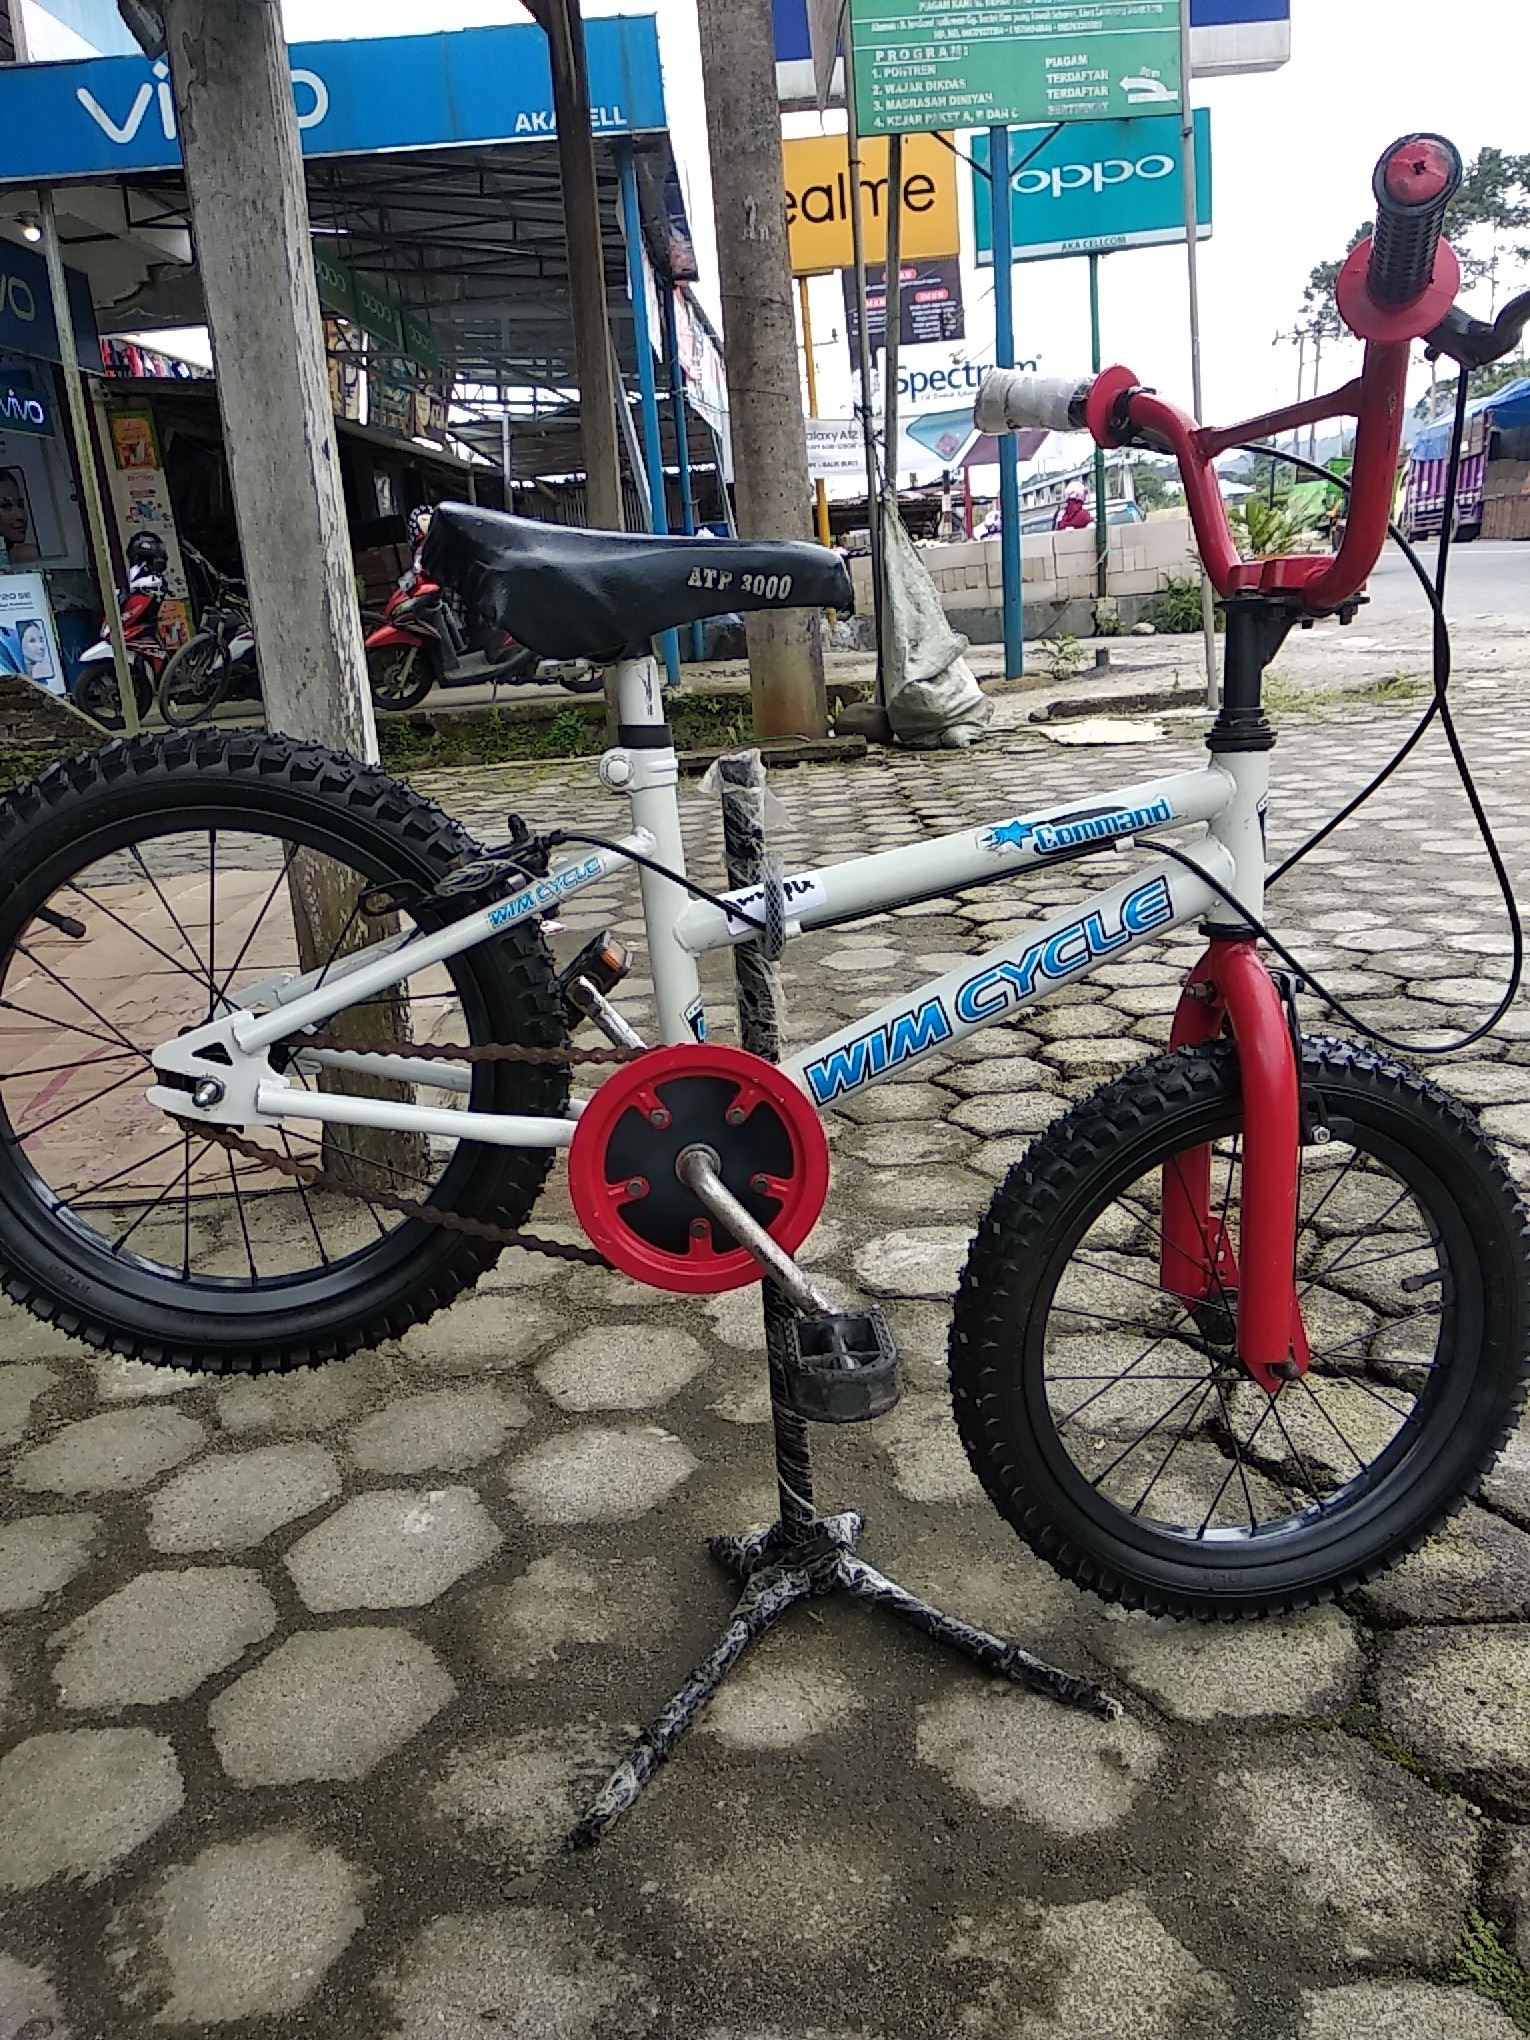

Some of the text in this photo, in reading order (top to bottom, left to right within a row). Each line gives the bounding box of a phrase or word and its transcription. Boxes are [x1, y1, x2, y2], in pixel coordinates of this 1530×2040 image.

[1045, 54, 1088, 68] PIAGAM
[872, 84, 882, 95] 2.
[925, 78, 967, 92] DIKDAS
[1046, 70, 1109, 84] TERDAFTAR
[76, 60, 329, 144] vio
[1046, 86, 1109, 100] TERDAFTAR
[590, 106, 628, 127] ELL
[873, 101, 884, 112] 3.
[873, 115, 885, 128] 4.
[1011, 154, 1176, 198] oppo
[785, 172, 937, 226] alme
[1083, 236, 1127, 249] CELLCOM
[897, 359, 1037, 403] Spectr
[806, 430, 838, 442] alaxy
[687, 566, 793, 600] ATP 3000
[1035, 798, 1172, 850] Command
[488, 857, 602, 929] WIM CYCLE
[804, 873, 1174, 1106] WIM CYCLE
